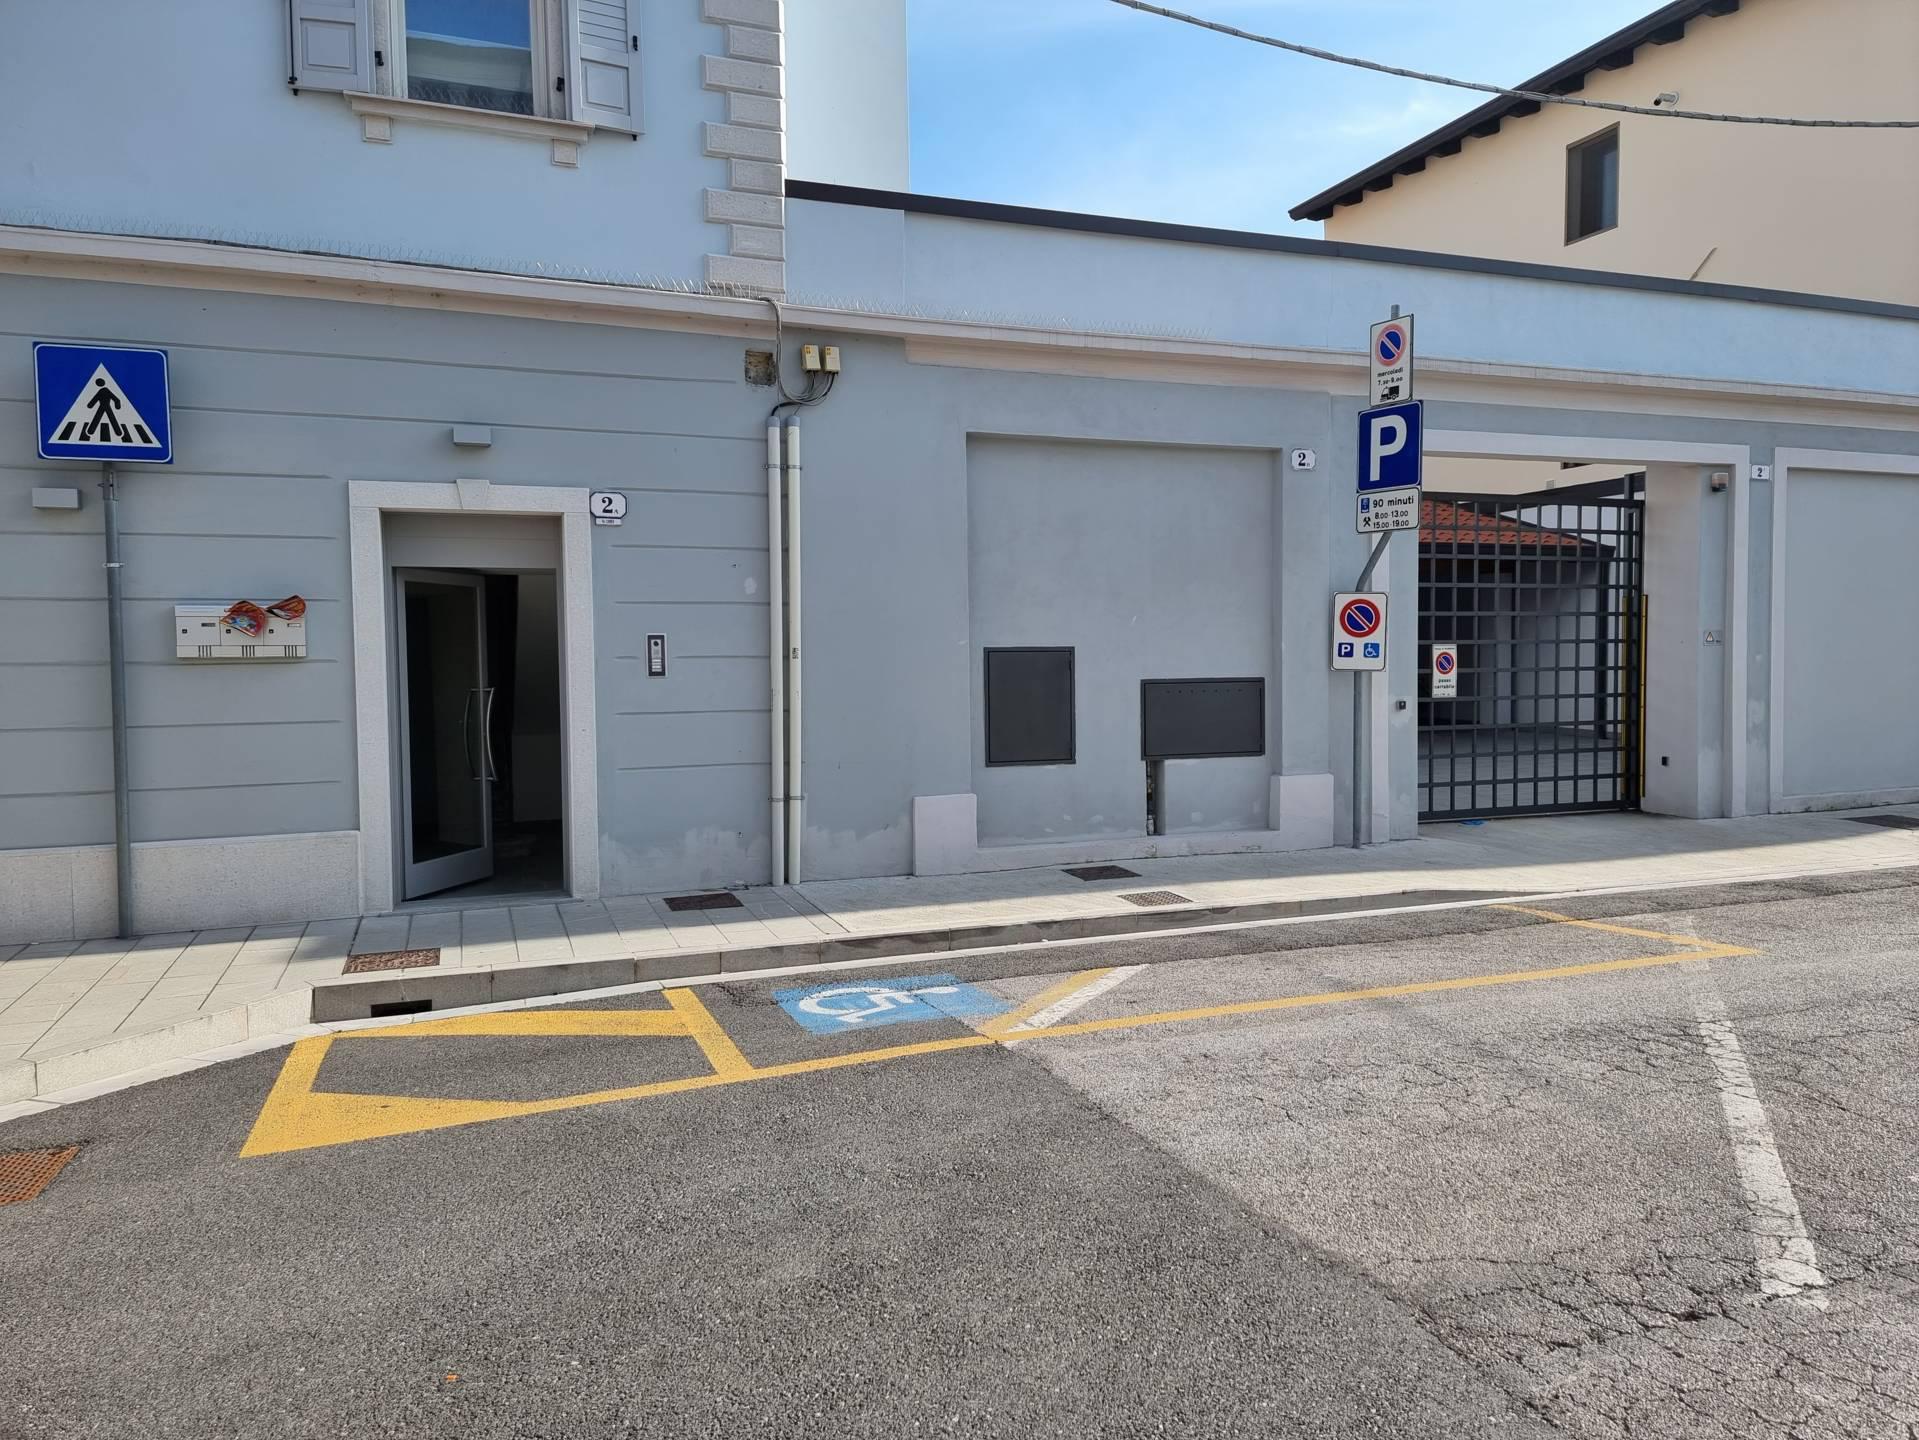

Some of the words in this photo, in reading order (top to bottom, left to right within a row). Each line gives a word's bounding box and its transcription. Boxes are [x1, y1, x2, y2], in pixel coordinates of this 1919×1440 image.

[1370, 415, 1407, 481] P
[1373, 499, 1384, 508] 90
[1388, 496, 1414, 506] minuti
[1341, 645, 1351, 656] P
